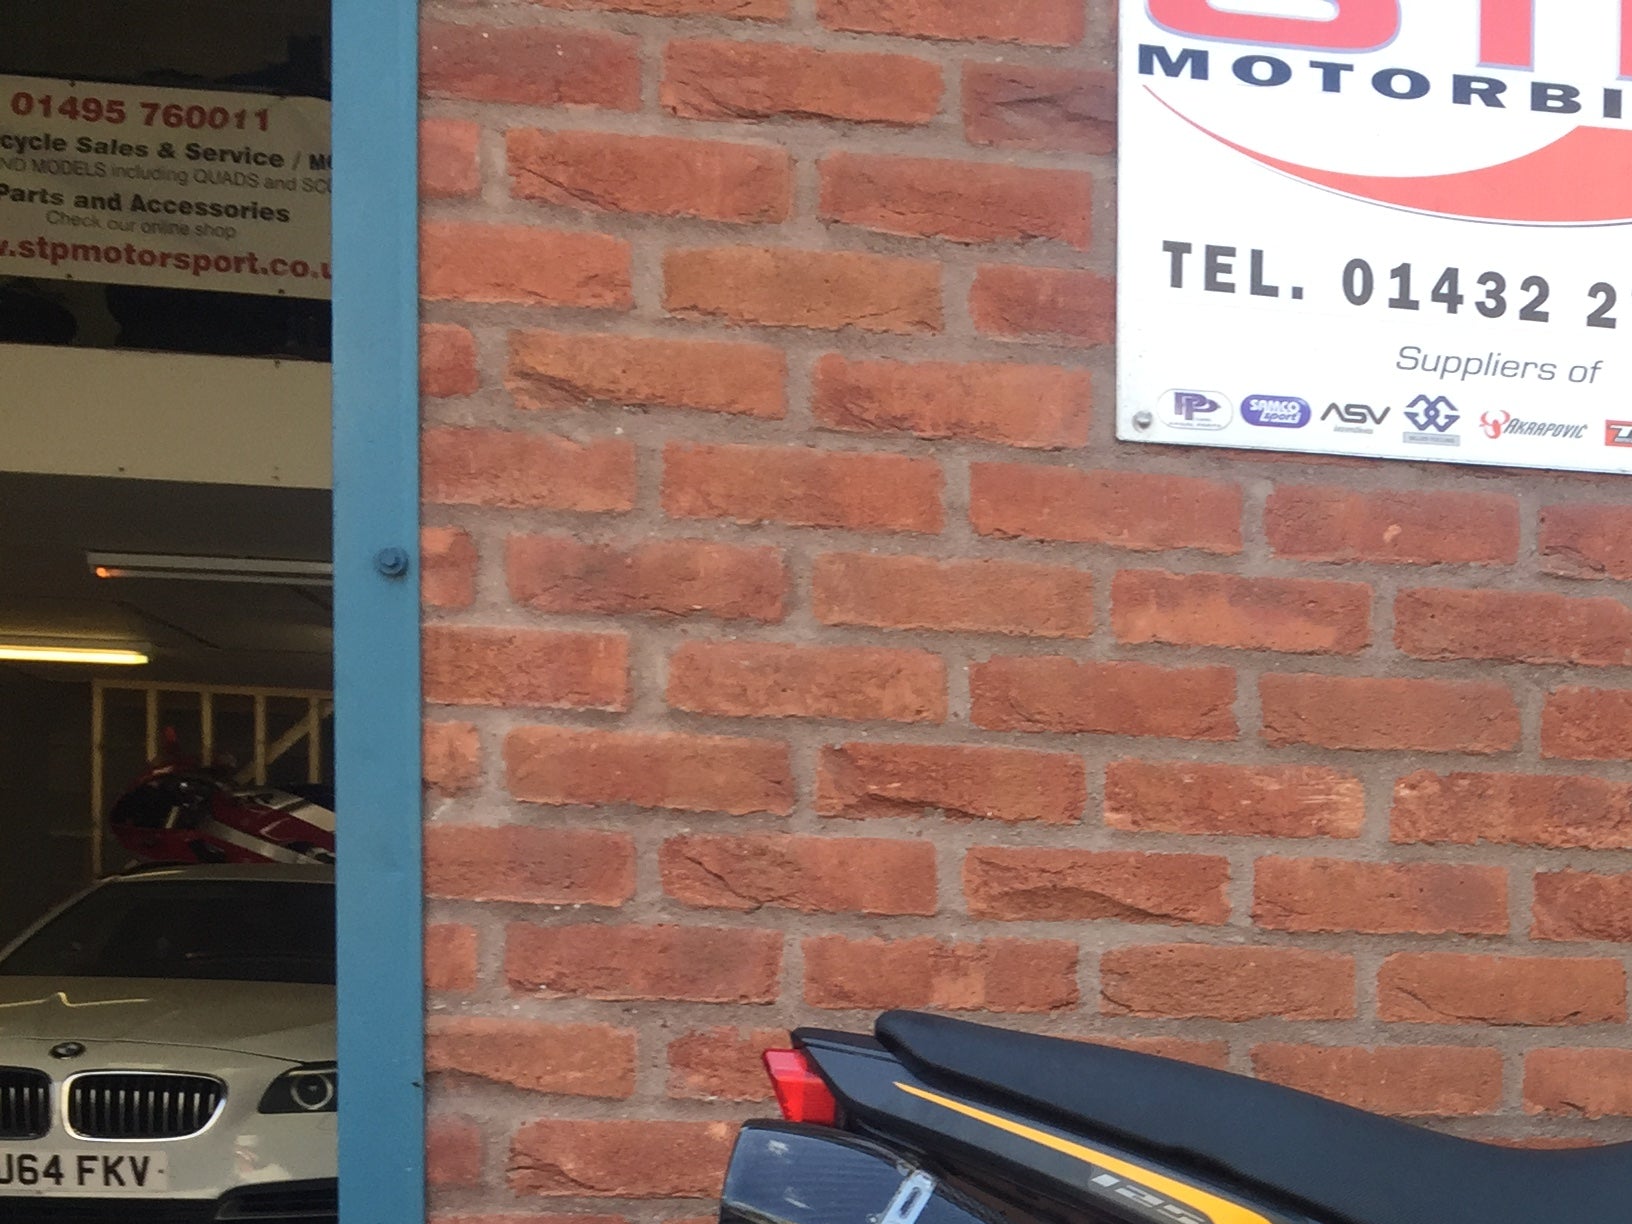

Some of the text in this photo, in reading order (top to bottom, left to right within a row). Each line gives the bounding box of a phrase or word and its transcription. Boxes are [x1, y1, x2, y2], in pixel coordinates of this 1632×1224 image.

[11, 91, 269, 132] 01495 760011
[76, 136, 149, 158] Sales
[157, 141, 176, 159] &
[185, 142, 285, 168] Service
[31, 158, 107, 178] MODELS
[112, 162, 189, 186] including
[194, 168, 260, 189] QUADS
[264, 174, 297, 192] and
[0, 182, 290, 223] Parts and Accessories
[46, 209, 237, 240] Check our online shop
[1162, 240, 1304, 300] TEL.
[1342, 258, 1550, 323] 01432
[1396, 345, 1604, 384] Suppliers of
[1249, 399, 1300, 414] SAMCO
[1262, 411, 1299, 423] sport
[1320, 402, 1391, 425] ASV
[76, 1155, 150, 1187] FKV
